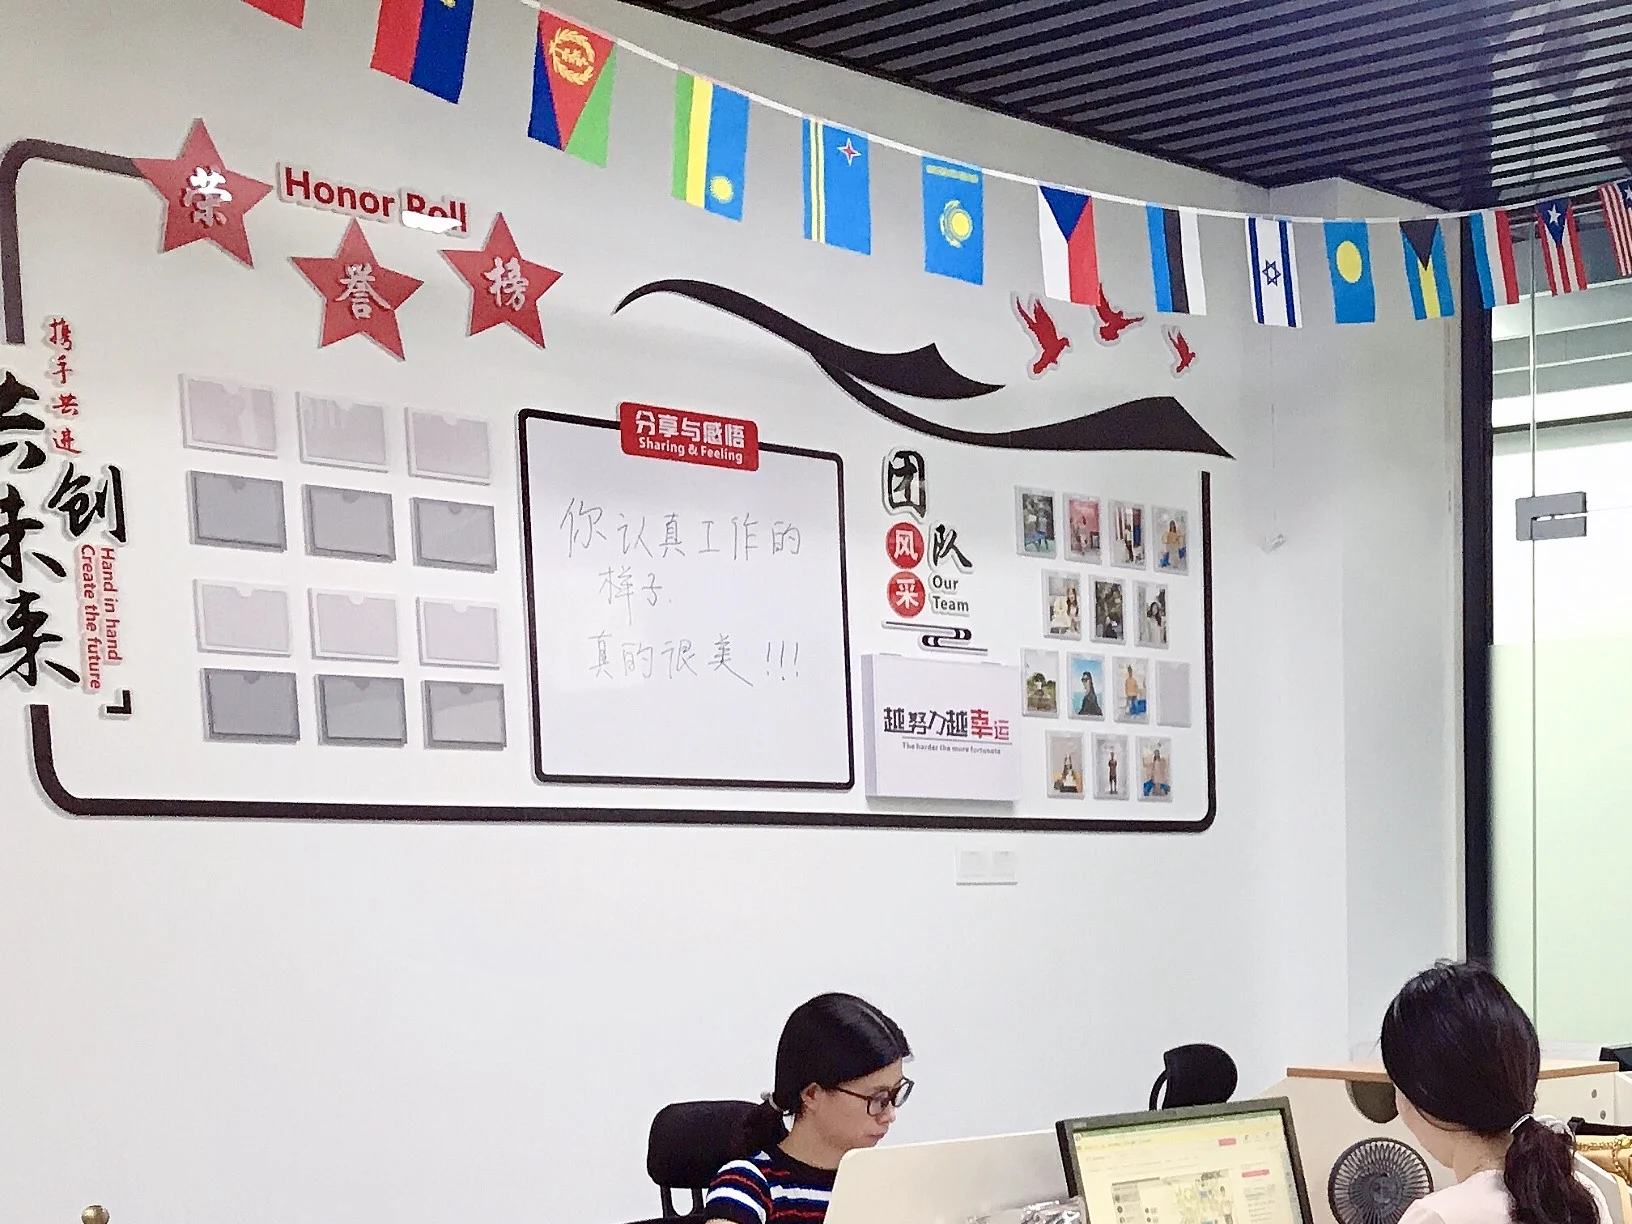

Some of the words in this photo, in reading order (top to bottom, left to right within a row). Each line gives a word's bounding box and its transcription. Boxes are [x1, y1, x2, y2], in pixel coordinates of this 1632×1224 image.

[285, 166, 396, 218] Honor
[335, 261, 392, 319] 誉
[483, 256, 529, 311] 榜
[49, 317, 82, 455] 携手共进
[635, 409, 745, 449] 分享与感悟
[638, 436, 685, 457] Sharing
[688, 443, 699, 456] &
[700, 445, 743, 464] Feeling
[560, 497, 801, 561] 你认真工作的
[81, 544, 97, 599] Create
[101, 547, 118, 592] Hand
[932, 574, 959, 590] Our
[85, 603, 100, 632] the
[104, 598, 119, 613] in
[932, 595, 970, 613] Team
[105, 619, 124, 661] hand
[87, 637, 103, 690] future
[902, 741, 915, 750] The
